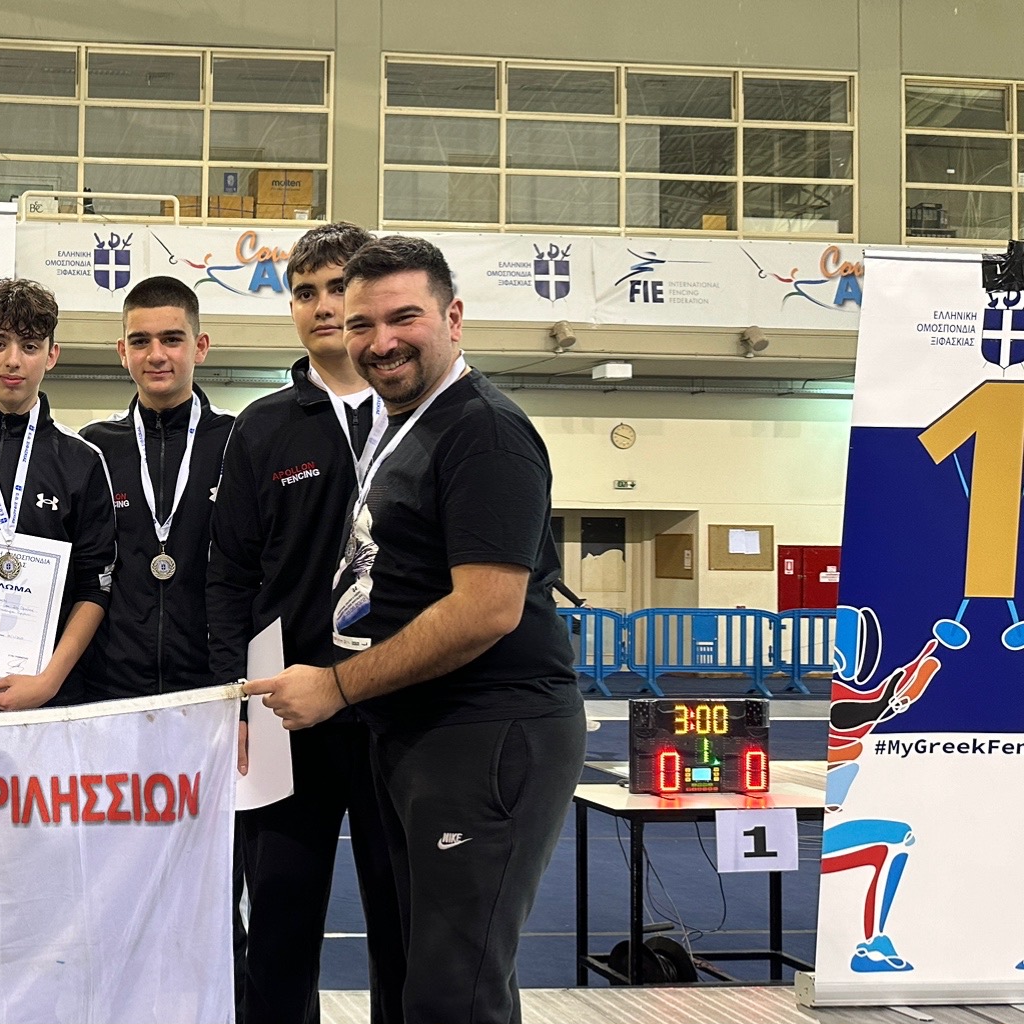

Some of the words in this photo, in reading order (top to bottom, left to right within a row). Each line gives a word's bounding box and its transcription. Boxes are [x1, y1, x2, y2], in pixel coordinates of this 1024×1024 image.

[271, 179, 301, 187] molten
[57, 250, 92, 258] ΕΛΛΗΝΙΚΗ
[45, 259, 92, 267] ΟΜΟΣΠΟΝΔΙΑ
[498, 261, 532, 269] ΕΛΛΗΝΙΚΗ
[57, 268, 92, 276] ΞΙΦΑΣΚΙΑΣ
[486, 269, 532, 278] ΟΜΟΣΠΟΝΔΙΑ
[498, 278, 532, 287] ΞΙΦΑΣΚΙΑΣ
[668, 281, 720, 289] INTERNATIONAL
[629, 280, 664, 303] FIE
[933, 310, 978, 321] ΕΛΛΗΝΙΚΗ
[916, 323, 976, 334] ΟΜΟΣΠΟΝΔΙΑ
[930, 336, 975, 347] ΞΙΦΑΣΚΙΑΣ
[272, 461, 316, 481] APOLLON
[281, 468, 320, 486] FENCING
[675, 705, 728, 734] 3:00
[660, 751, 681, 791] 0
[745, 750, 767, 791] 0
[442, 832, 463, 843] NIKE
[742, 826, 778, 858] 1
